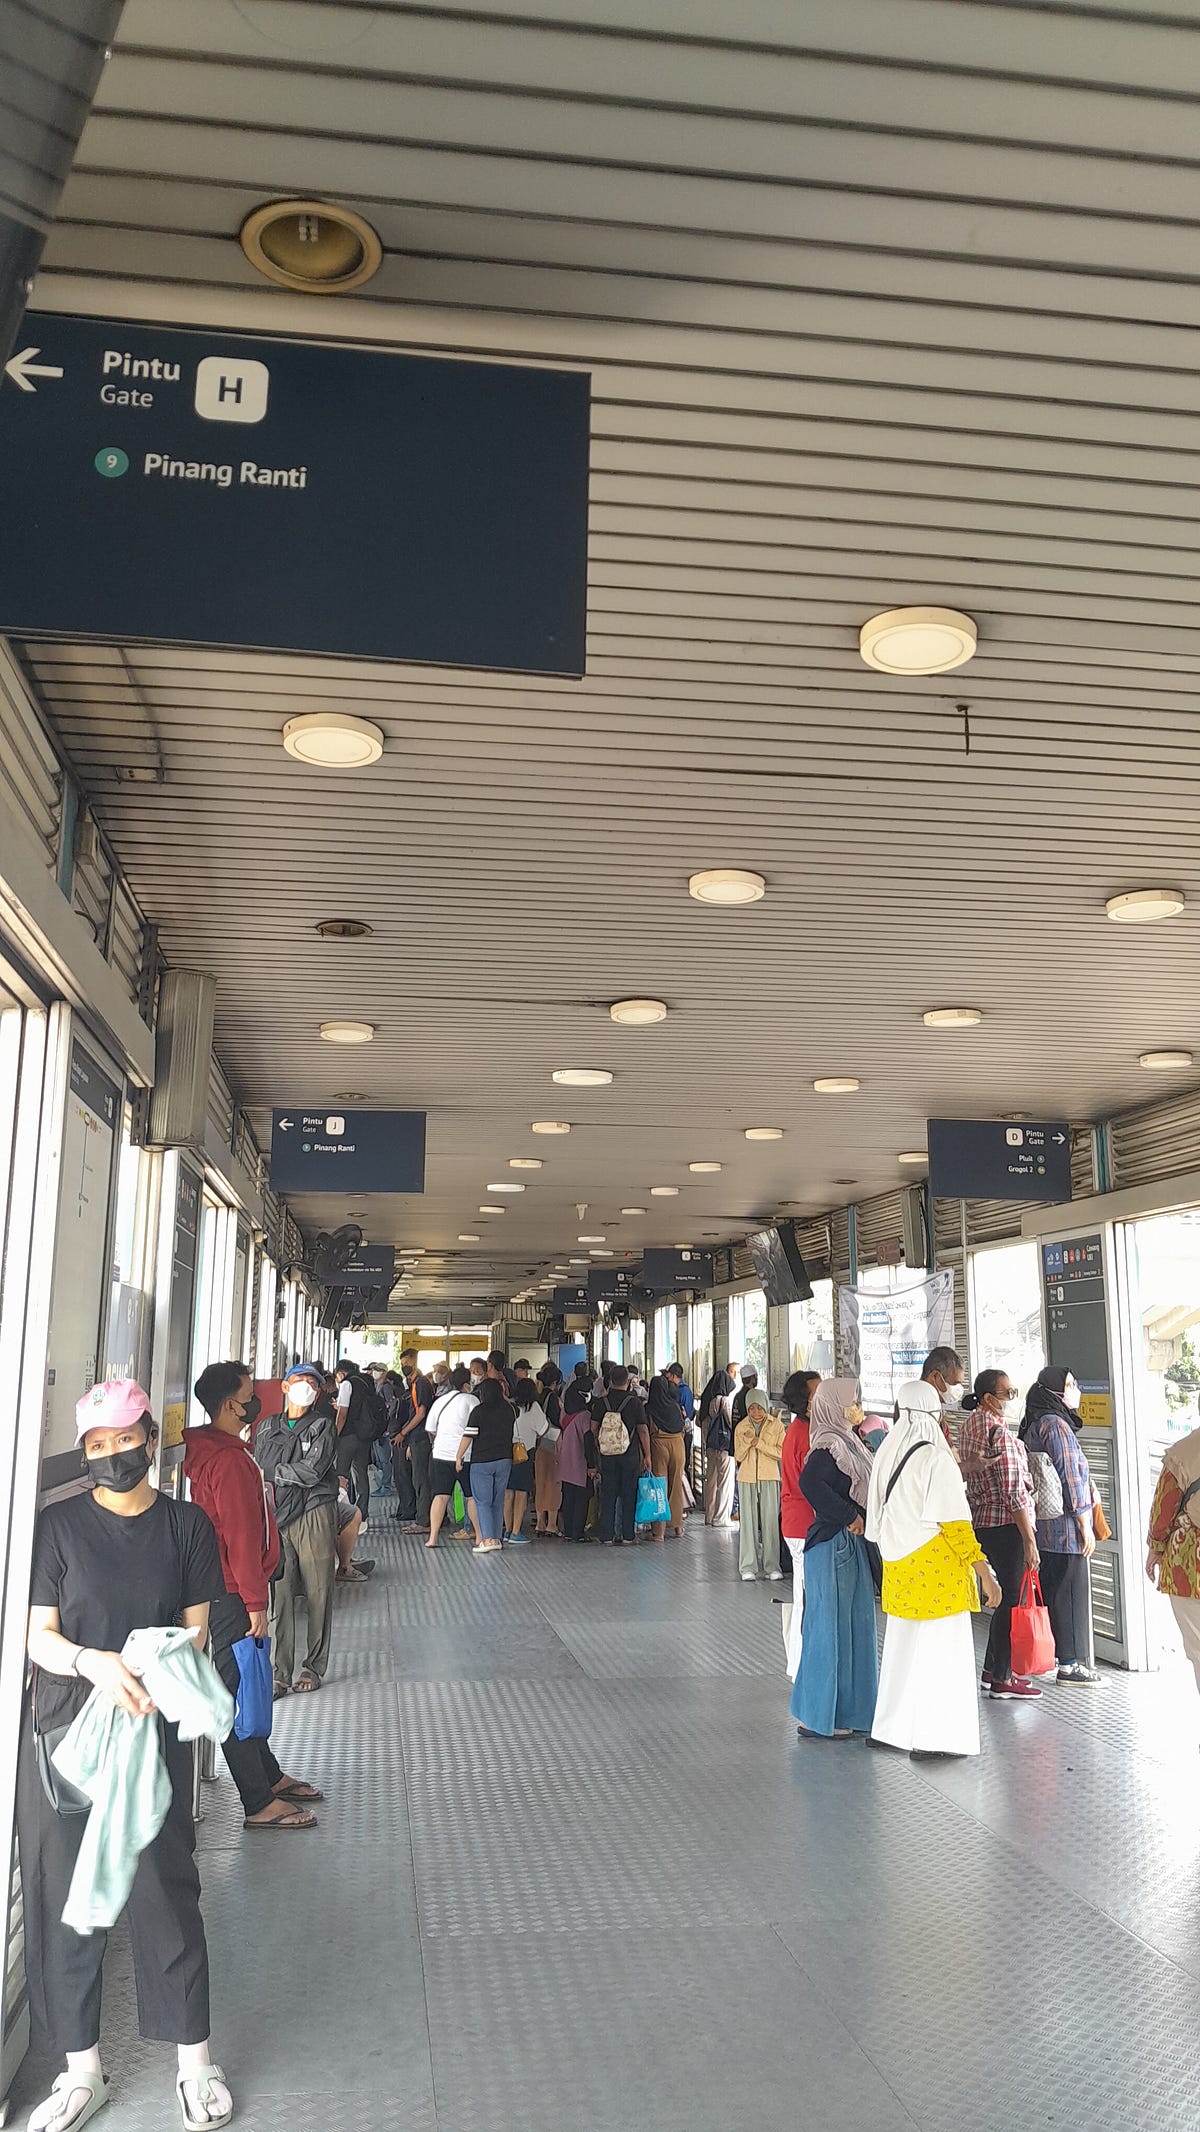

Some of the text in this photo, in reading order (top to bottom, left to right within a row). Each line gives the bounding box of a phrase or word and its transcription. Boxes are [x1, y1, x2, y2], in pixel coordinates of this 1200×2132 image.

[102, 350, 181, 381] Pintu
[100, 384, 154, 407] Gate
[218, 375, 243, 404] H
[106, 454, 117, 469] 9
[143, 453, 308, 488] Pinang Ranti
[302, 1117, 323, 1125] Pintu
[1025, 1130, 1044, 1138] Pintu
[1028, 1137, 1045, 1145] Gate
[313, 1143, 337, 1153] Pinang
[337, 1144, 356, 1152] Ranti
